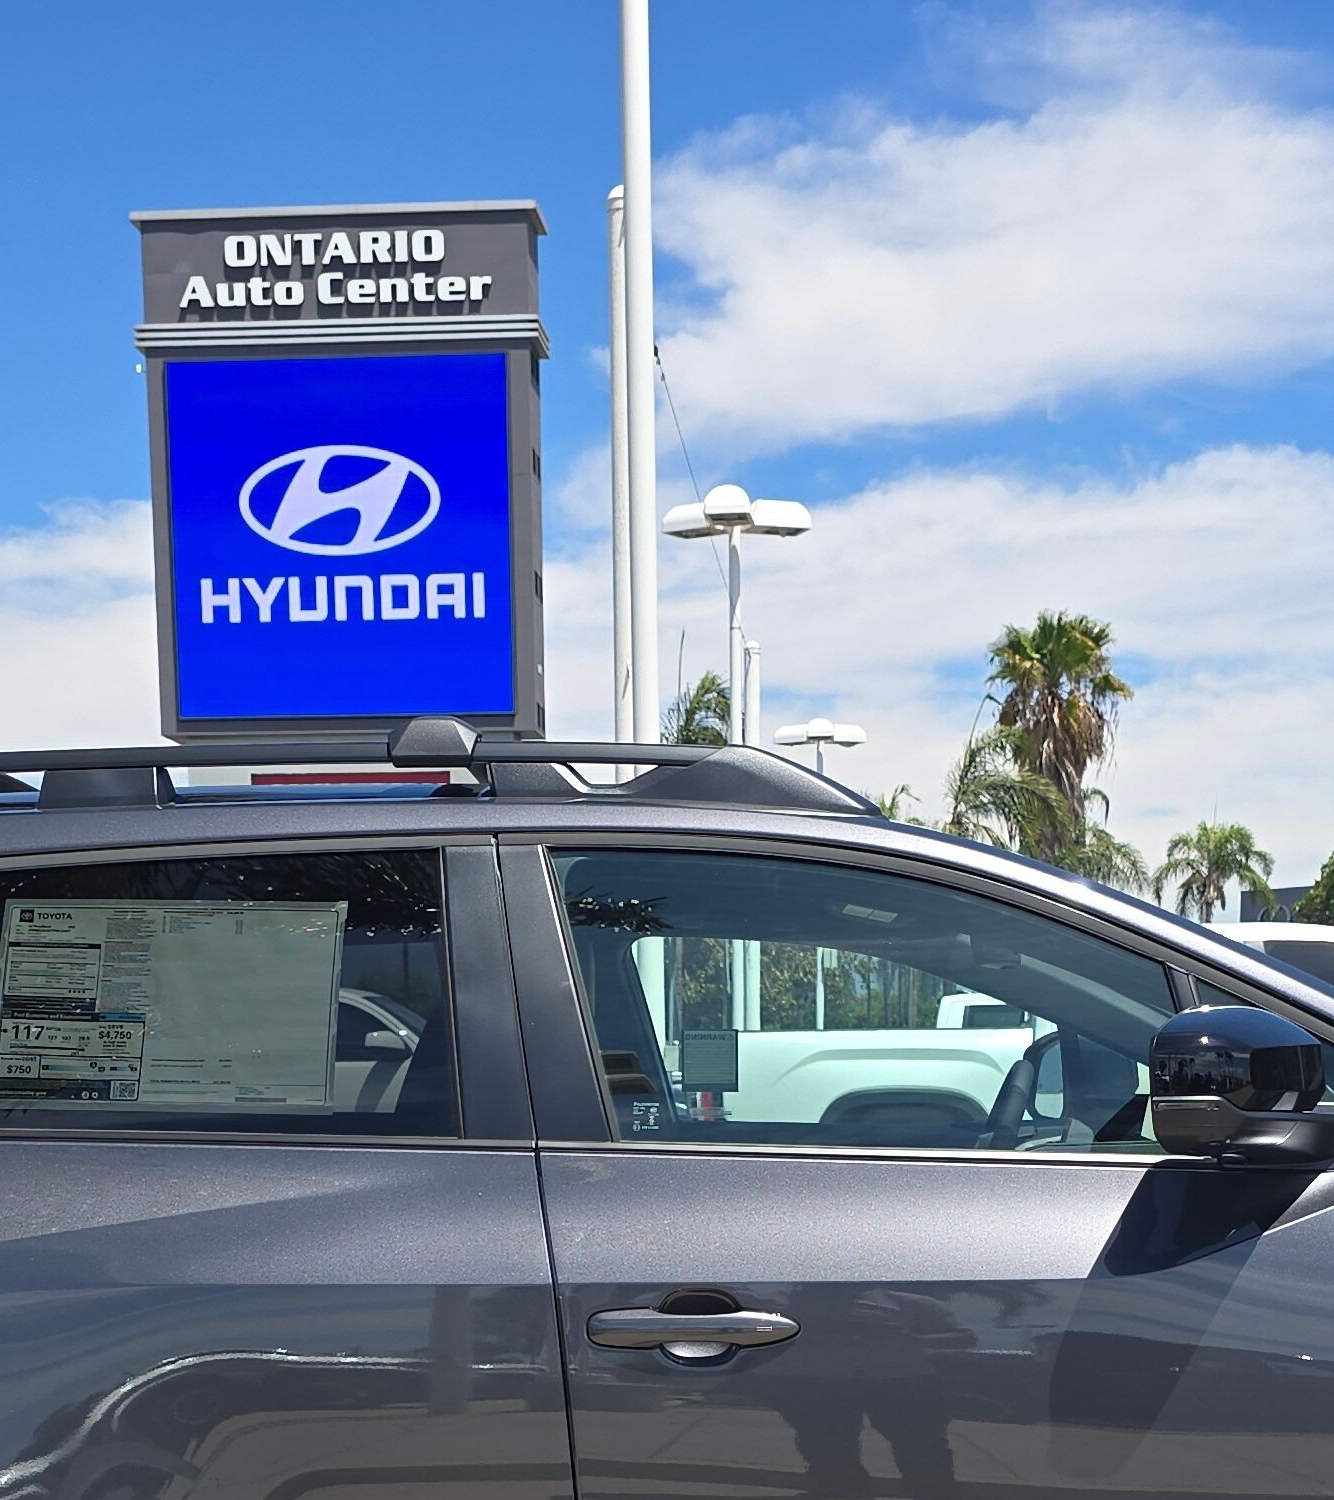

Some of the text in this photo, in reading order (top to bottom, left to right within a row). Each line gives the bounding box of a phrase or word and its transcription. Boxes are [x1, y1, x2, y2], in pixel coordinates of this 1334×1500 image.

[223, 229, 445, 268] ONTARIO
[179, 271, 492, 308] Auto Center
[200, 572, 486, 624] HYUNDAI
[37, 912, 73, 921] TOYOTA
[11, 1024, 45, 1041] 117
[98, 1030, 132, 1040] $4,750
[6, 1064, 32, 1075] $750
